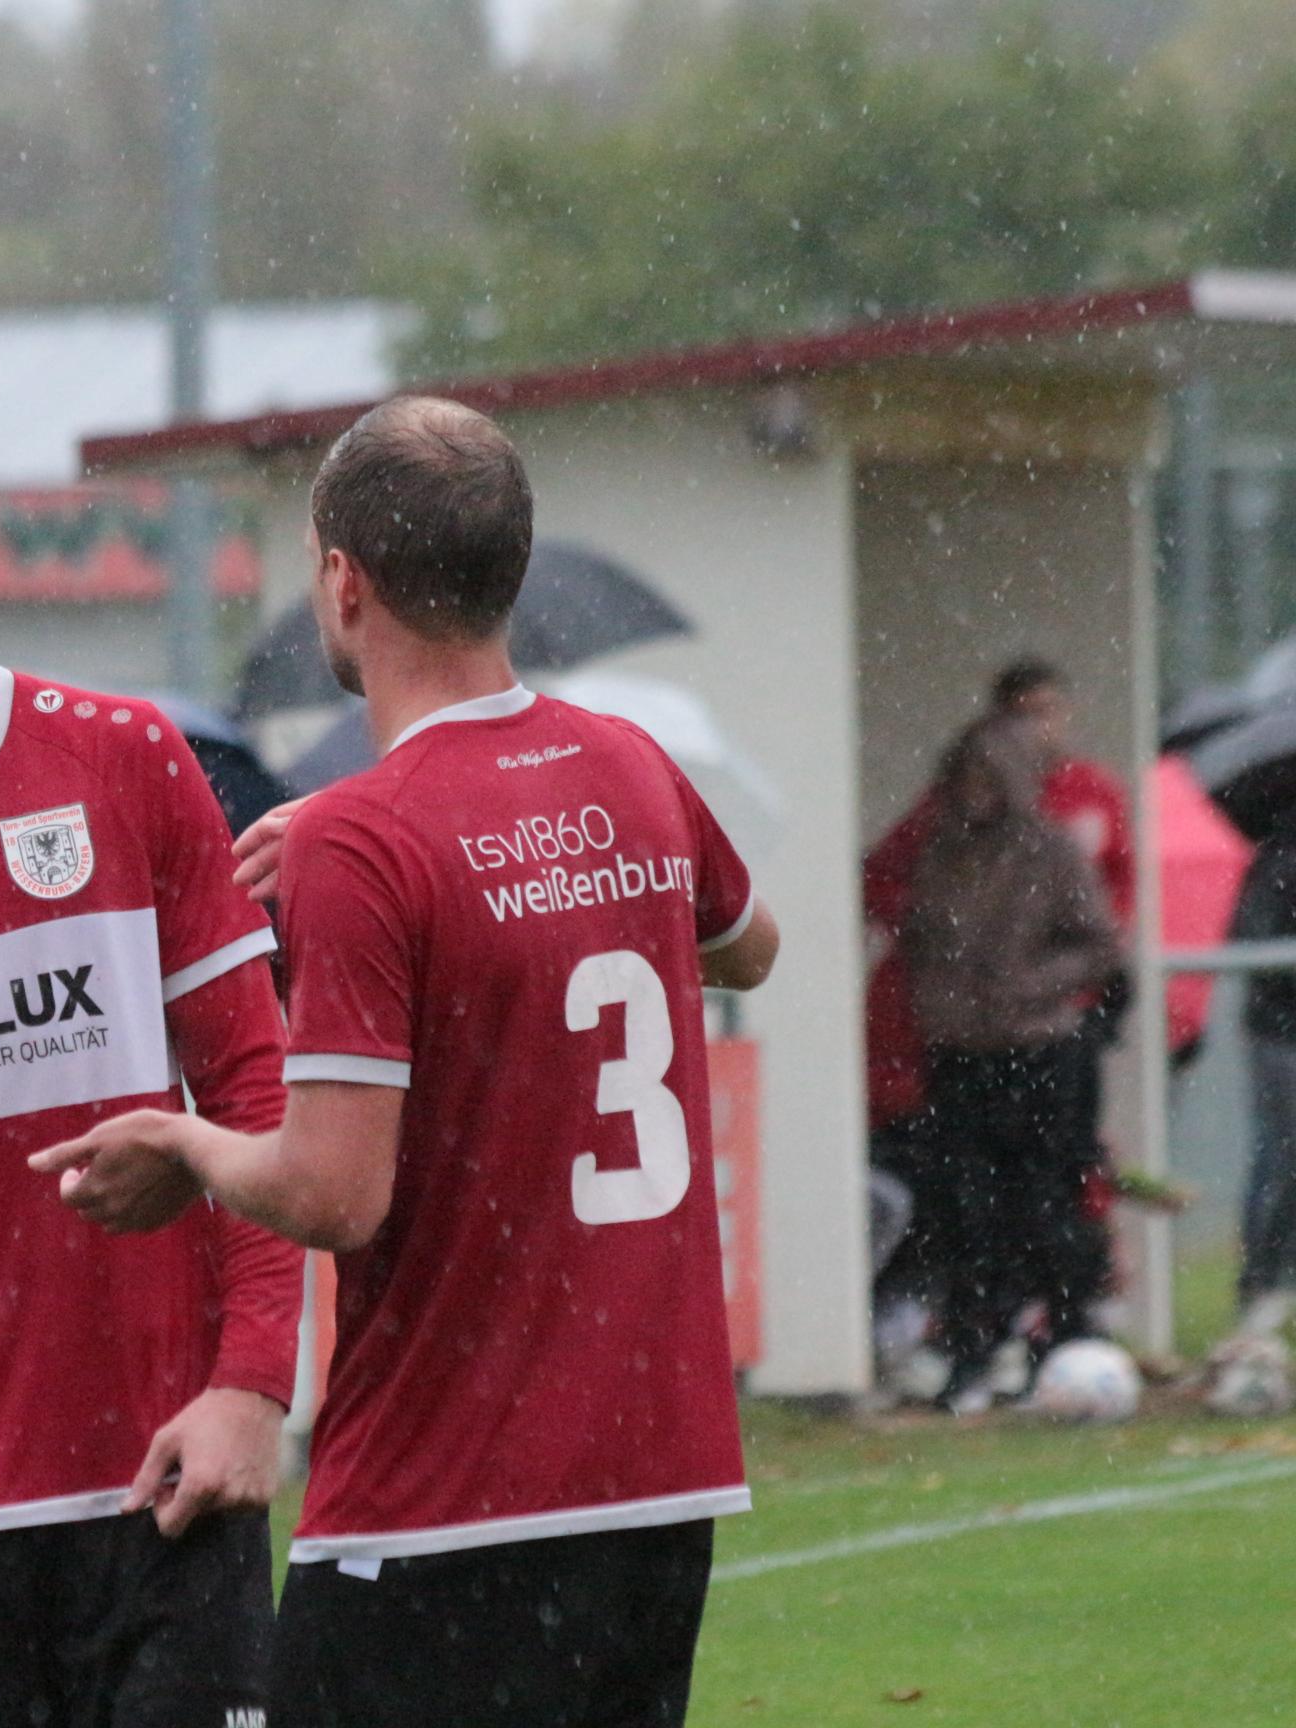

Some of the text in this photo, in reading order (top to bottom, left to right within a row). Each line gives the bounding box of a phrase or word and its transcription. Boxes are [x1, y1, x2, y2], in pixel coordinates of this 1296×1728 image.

[458, 805, 615, 871] tsv1860
[483, 853, 694, 923] weißenburg
[19, 1025, 110, 1064] QUALITÄT
[565, 949, 691, 1225] 3
